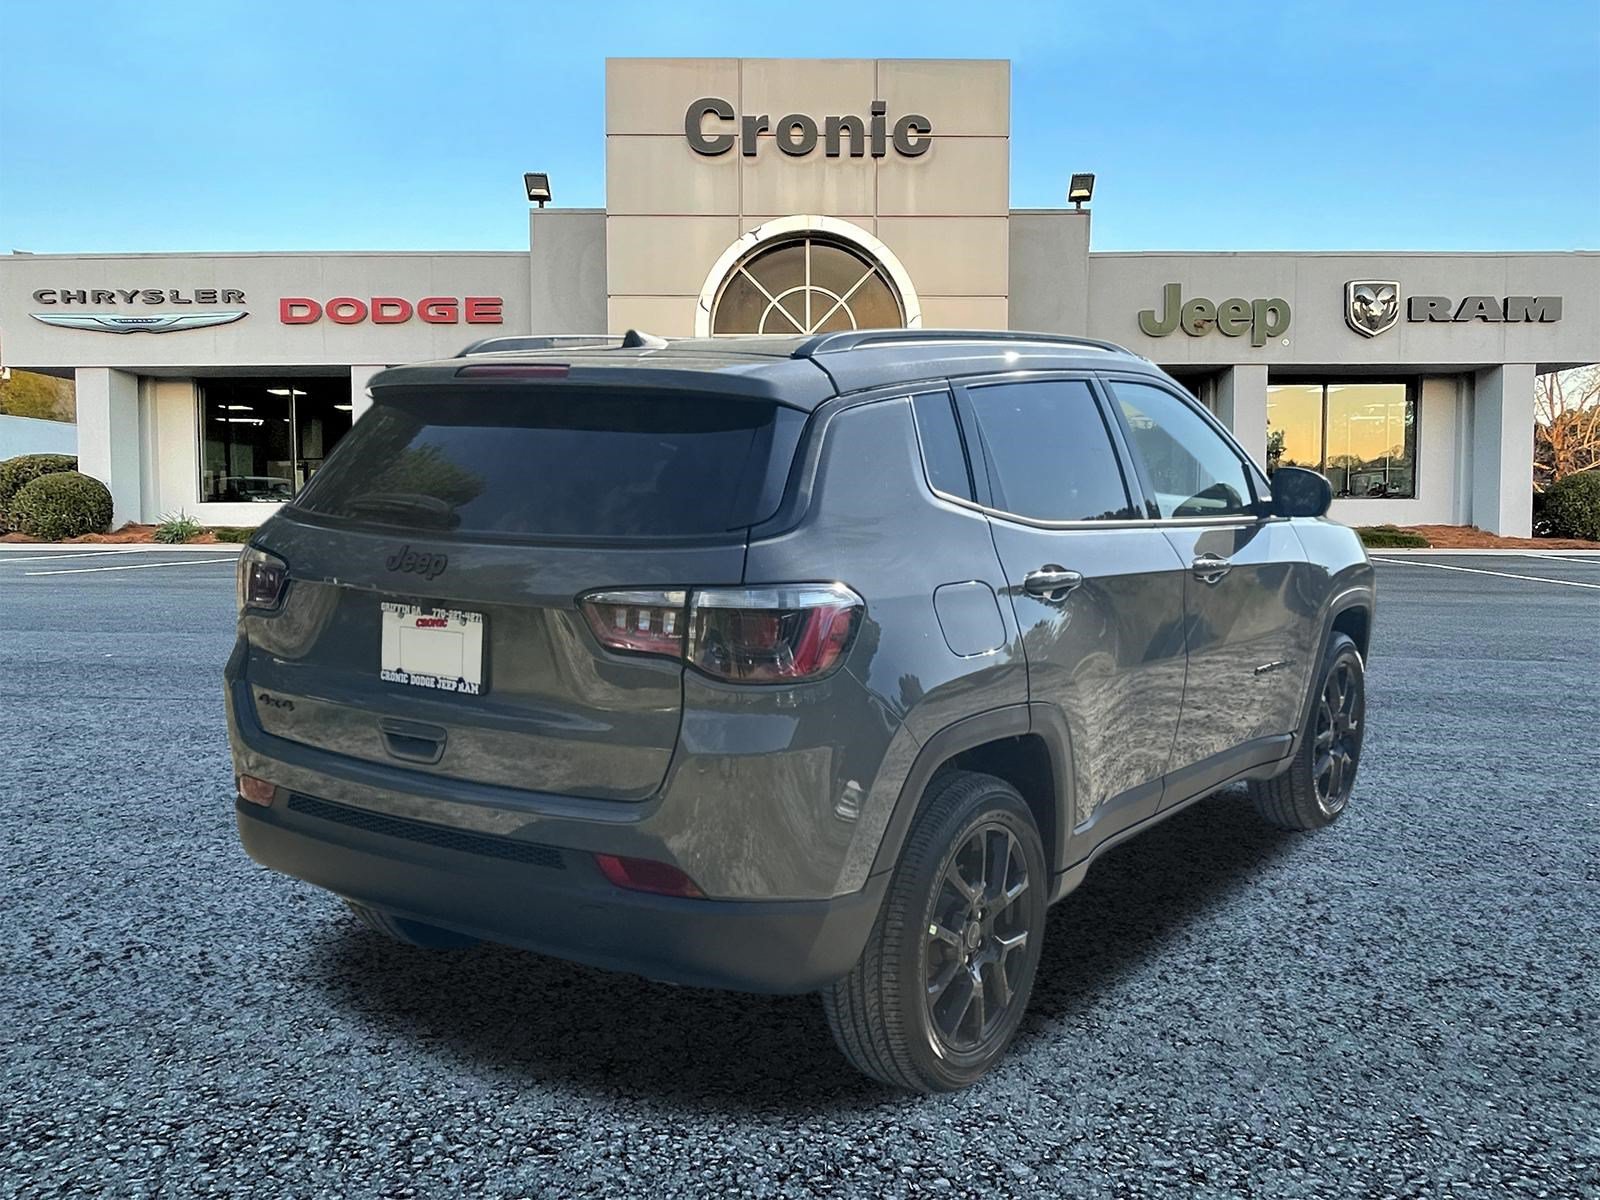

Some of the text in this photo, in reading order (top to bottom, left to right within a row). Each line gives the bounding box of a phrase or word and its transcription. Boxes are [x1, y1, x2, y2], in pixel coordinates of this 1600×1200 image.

[685, 97, 932, 158] Cronic
[32, 287, 247, 305] CHRYSLER
[280, 296, 503, 325] DODGE
[1407, 295, 1563, 323] RAM
[1138, 283, 1291, 347] Jeep
[385, 544, 449, 581] Jeep
[410, 675, 436, 688] DODGE
[436, 679, 458, 691] JEEP
[457, 682, 480, 695] RAM
